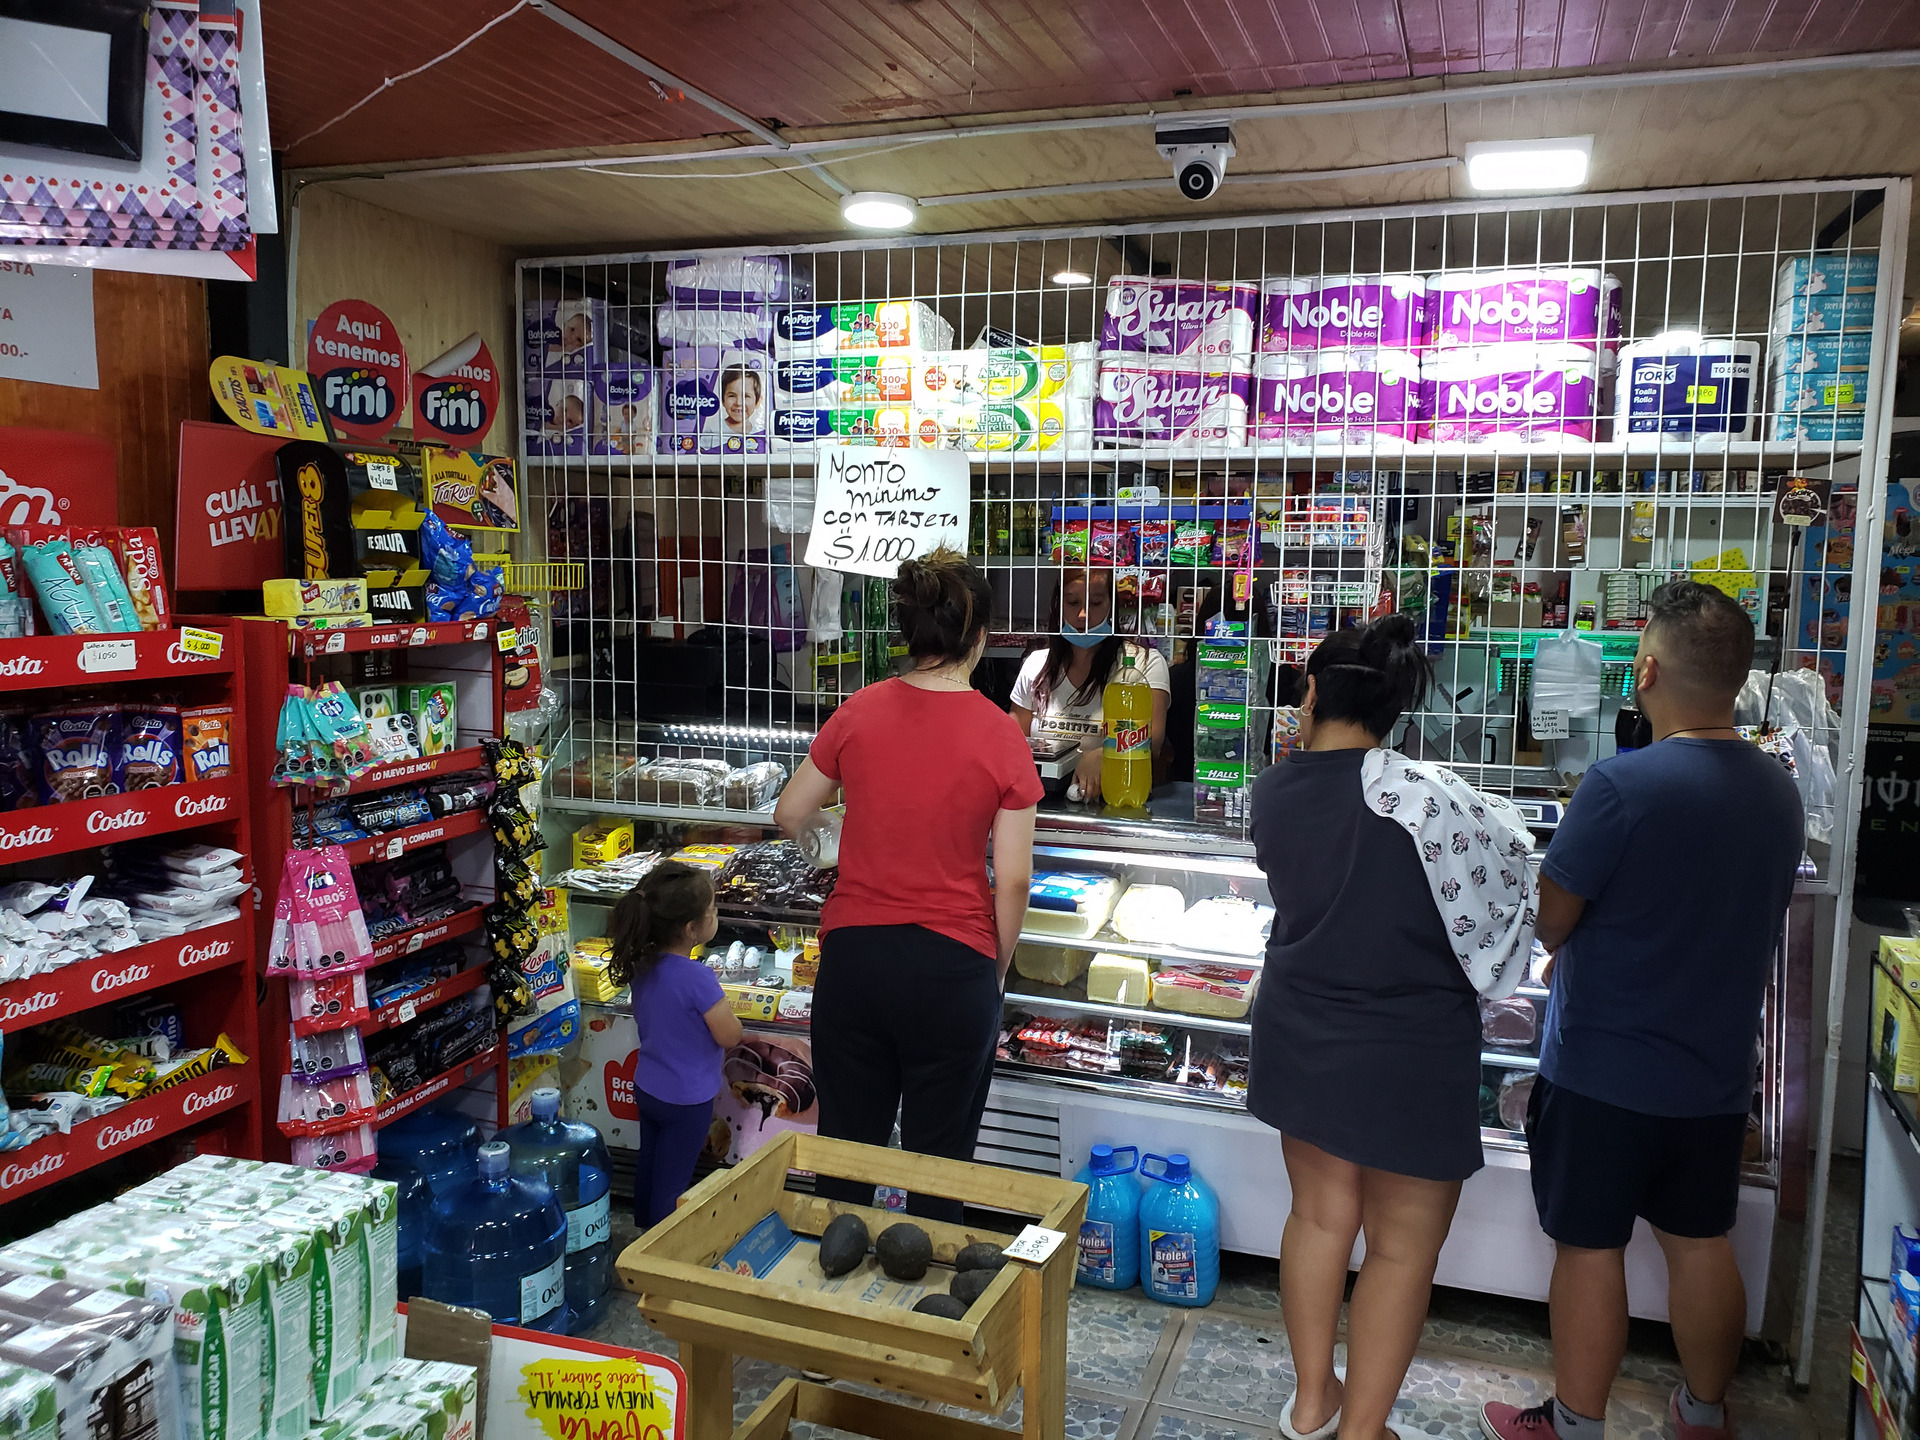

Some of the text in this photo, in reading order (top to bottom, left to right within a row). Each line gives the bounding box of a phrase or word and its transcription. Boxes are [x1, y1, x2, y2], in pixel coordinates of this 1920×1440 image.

[0, 261, 35, 277] STA
[1118, 289, 1227, 336] Swan
[1282, 298, 1384, 328] Noble
[1451, 293, 1562, 325] Noble
[336, 314, 382, 341] Aquí
[781, 314, 822, 326] ProPaper
[1514, 326, 1558, 335] Doble Hoja
[527, 330, 560, 340] Babysec
[1363, 330, 1378, 339] Hoj
[315, 335, 400, 368] tenemos
[1637, 370, 1674, 381] TORK
[325, 376, 387, 418] Fini
[609, 385, 638, 395] Babysec
[1113, 376, 1221, 423] Swan
[1273, 383, 1375, 414] Noble
[1447, 383, 1556, 414] Noble
[427, 388, 480, 428] Fini
[526, 406, 553, 417] abysec
[669, 394, 715, 409] Babysec
[779, 415, 820, 427] ProPaper
[979, 412, 1004, 424] Don
[205, 479, 279, 518] CUÁL T
[450, 484, 476, 504] Rosa
[823, 510, 867, 525] con
[125, 536, 151, 592] Soda
[146, 546, 159, 579] Costa
[371, 634, 398, 644] LO NUEV
[0, 655, 44, 676] sta
[1205, 649, 1247, 661] Trident
[1208, 710, 1241, 721] HALLS
[60, 720, 92, 733] Costa
[1041, 719, 1099, 734] POSITIVE
[1117, 723, 1149, 753] Kem
[46, 742, 109, 773] Rolls
[123, 740, 174, 766] Rolls
[192, 742, 231, 773] Roll
[372, 772, 381, 781] LO
[383, 768, 405, 780] NUEVO
[406, 767, 416, 776] DE
[1207, 769, 1240, 780] HALLS
[175, 795, 228, 818] Costa
[87, 808, 147, 834] Costa
[360, 808, 396, 827] TRITON
[408, 828, 444, 845] COMPARTIR
[307, 891, 346, 909] TUBOS
[178, 940, 231, 967] Costa
[374, 945, 393, 959] ALGO
[521, 950, 549, 974] Rosa
[91, 964, 151, 994] Costa
[612, 1077, 634, 1090] Bre
[183, 1084, 235, 1115] Costa
[377, 1078, 449, 1121] ALGO PARA COMPARTIR
[97, 1115, 155, 1150] Costa
[1, 1152, 66, 1190] Costa
[1077, 1235, 1106, 1248] Brolex
[1155, 1250, 1187, 1261] Brolex
[316, 1291, 327, 1344] AZÚCAR
[208, 1354, 221, 1406] AZÚCAR
[558, 1369, 602, 1390] Sabor,
[607, 1373, 647, 1391] Leche
[529, 1390, 655, 1415] NUEVA FÓRMULA
